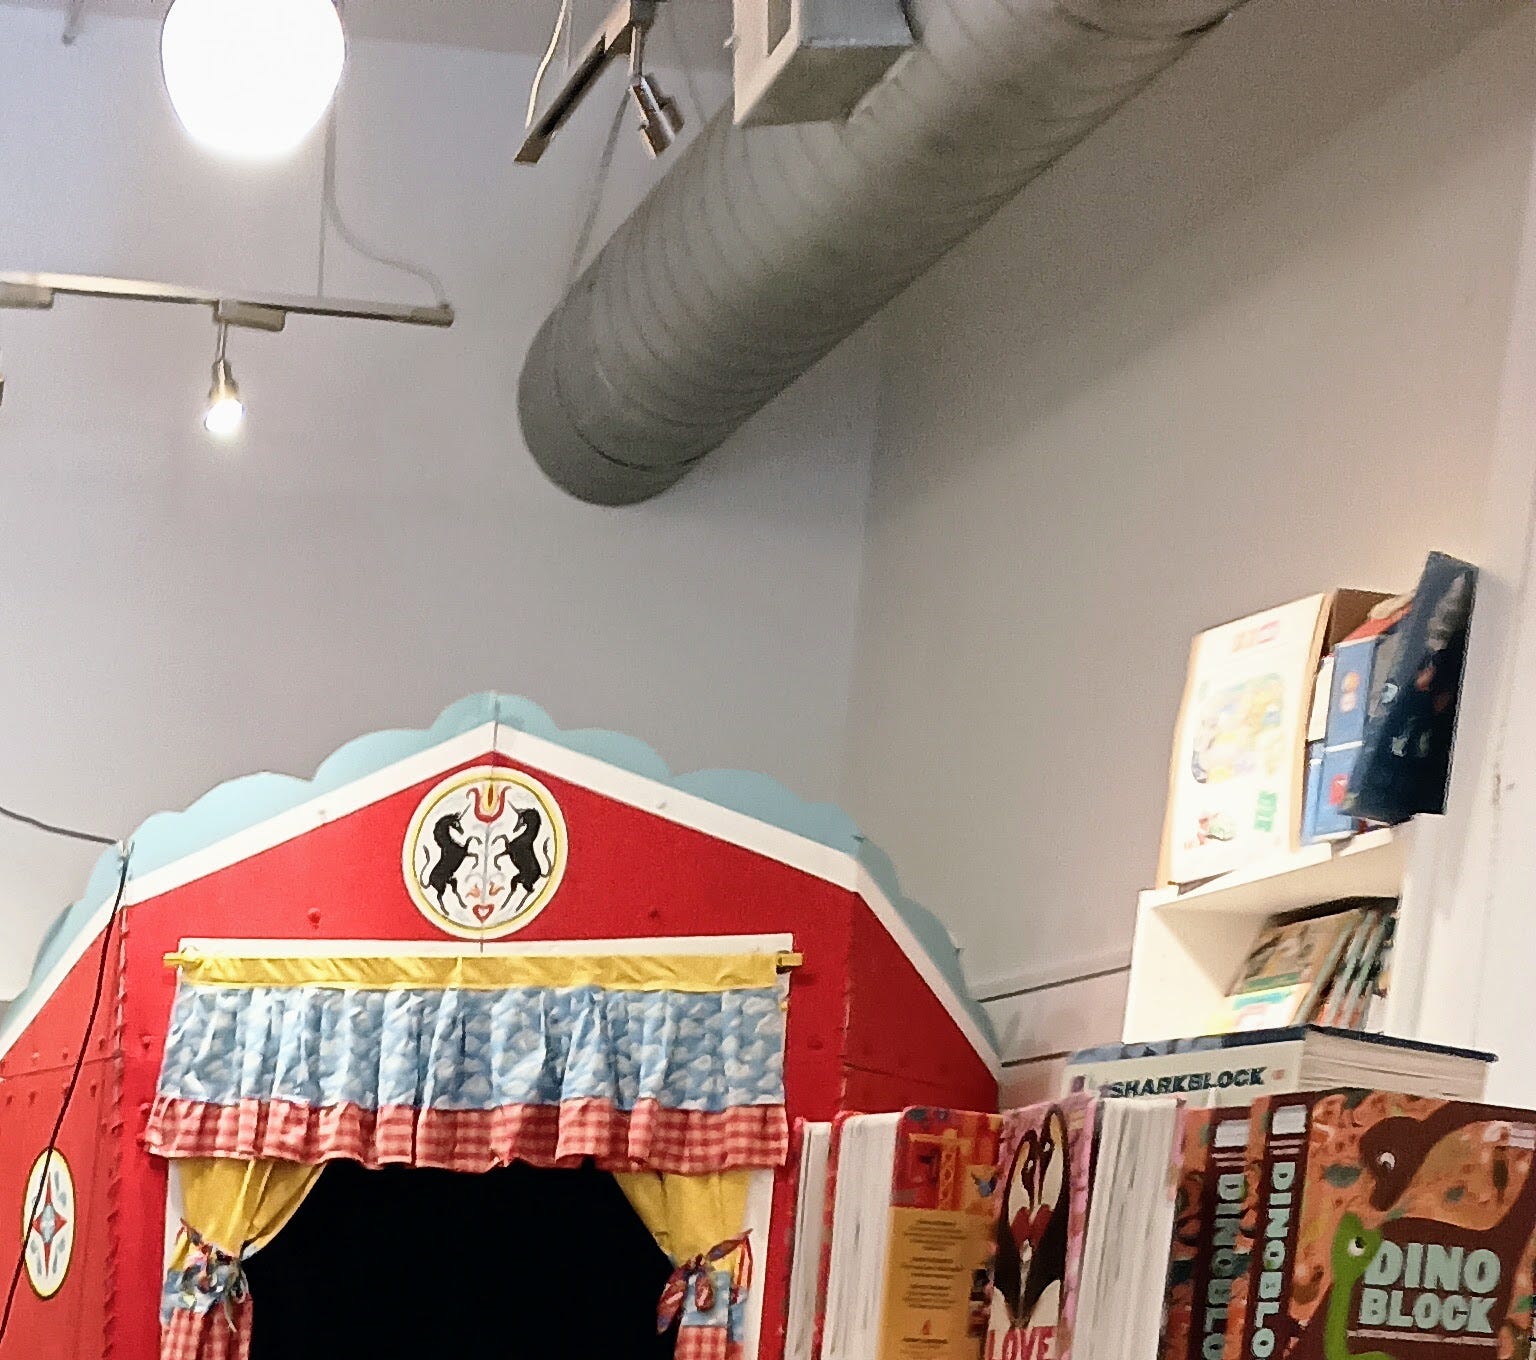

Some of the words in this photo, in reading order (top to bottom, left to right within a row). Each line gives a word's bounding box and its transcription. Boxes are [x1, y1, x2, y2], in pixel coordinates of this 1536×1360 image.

[1110, 1066, 1267, 1098] SHARKBLOCK
[1364, 1239, 1501, 1294] DINO
[1358, 1288, 1499, 1333] BLOCK
